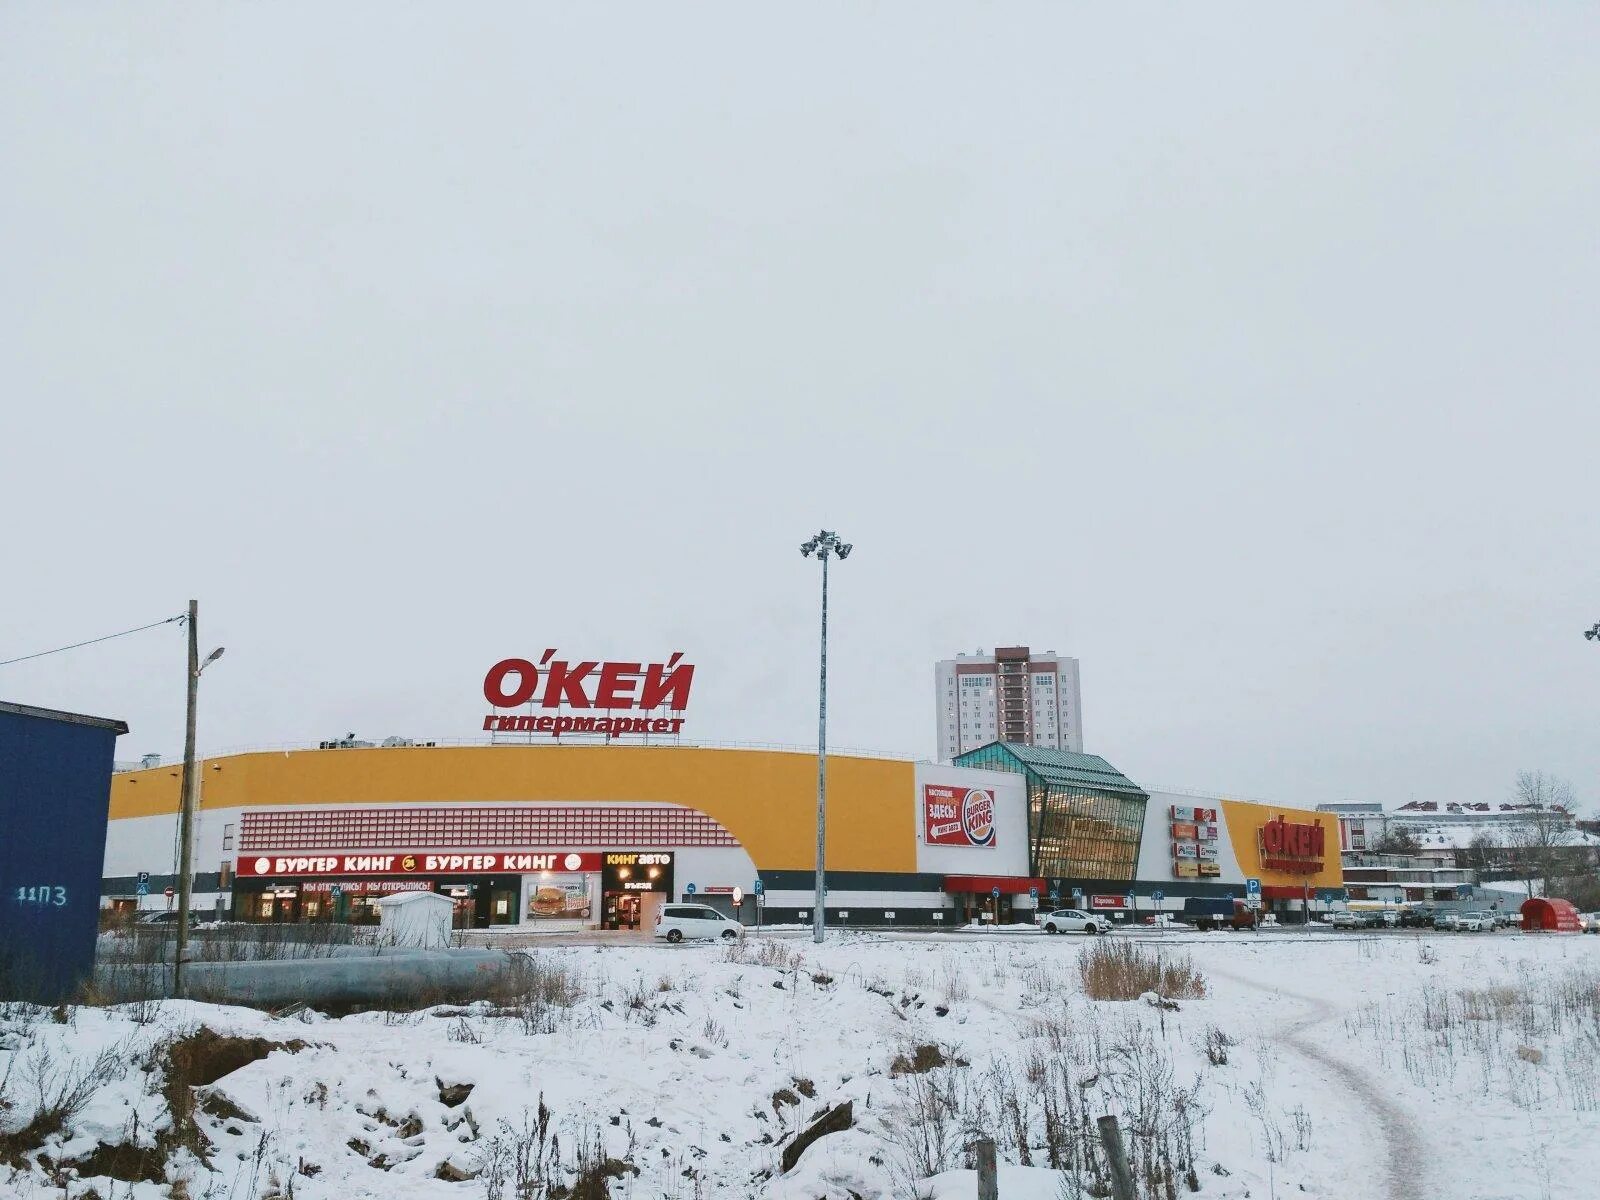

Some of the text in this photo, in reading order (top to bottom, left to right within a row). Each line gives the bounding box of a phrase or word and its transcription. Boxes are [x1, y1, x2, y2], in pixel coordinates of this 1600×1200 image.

[482, 714, 685, 738] гипермаркет
[929, 804, 957, 819] ЗДЕСЬ!
[966, 800, 991, 818] BURGER
[967, 810, 992, 832] KING
[275, 857, 338, 873] БУРГЕР
[344, 856, 395, 871] КИНГ
[425, 855, 496, 870] БУРГЕР
[504, 855, 557, 870] КИНГ
[366, 882, 381, 891] МЫ
[381, 881, 431, 891] ОТКРЫЛИСЬ!
[1250, 880, 1258, 892] P
